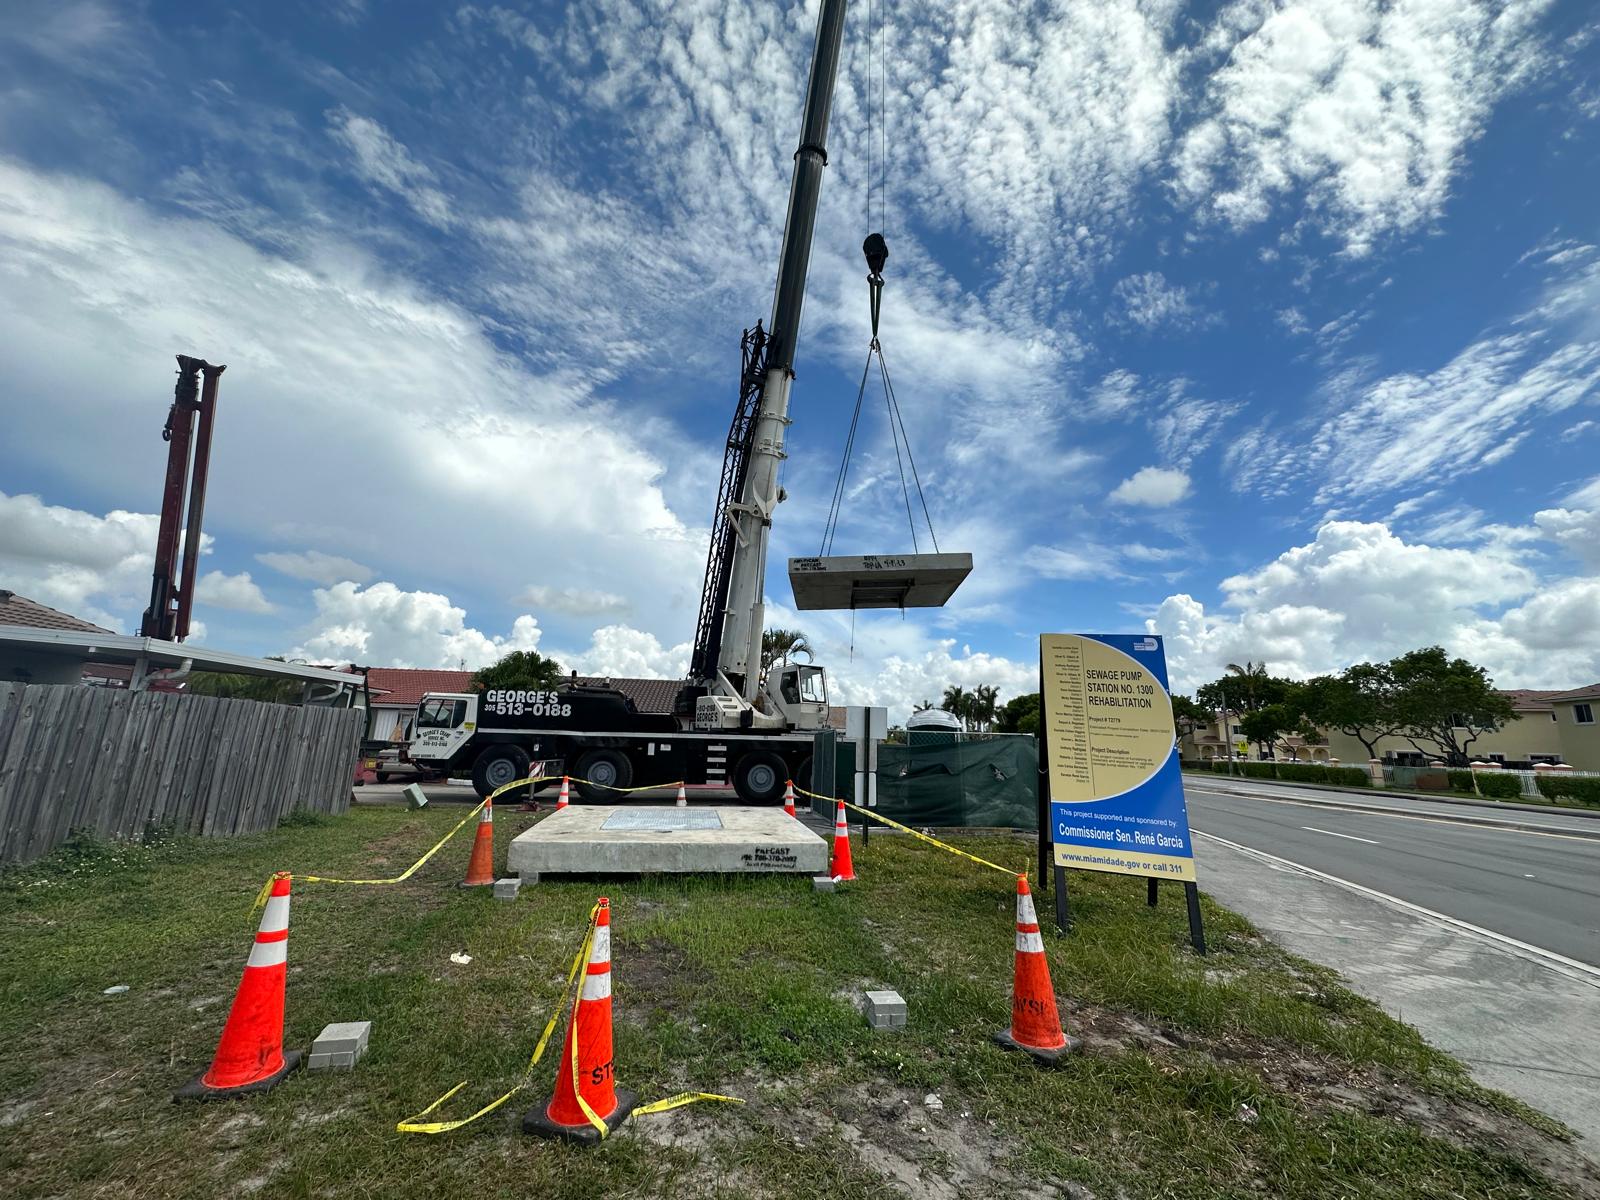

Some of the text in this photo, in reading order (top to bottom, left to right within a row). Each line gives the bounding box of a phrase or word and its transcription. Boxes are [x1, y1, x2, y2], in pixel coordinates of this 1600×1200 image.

[1086, 669, 1118, 680] SEWAGE
[1120, 671, 1142, 681] PUMP
[1088, 683, 1119, 693] STATION
[1121, 684, 1134, 694] NO.
[1136, 685, 1154, 695] 1300
[486, 689, 559, 704] GEORGE'S
[1088, 696, 1152, 708] REHABILITATION
[496, 703, 572, 717] 513-0188
[1060, 808, 1072, 816] This
[1073, 810, 1093, 819] project
[1093, 813, 1122, 822] supported
[1136, 817, 1168, 826] sponsored
[1168, 820, 1177, 828] by:
[1059, 823, 1114, 841] Commissioner
[1116, 829, 1134, 843] Sen.
[1135, 831, 1155, 845] René
[1062, 853, 1140, 869] www.miamidade.gov
[1153, 862, 1167, 872] call
[1170, 864, 1183, 873] 311
